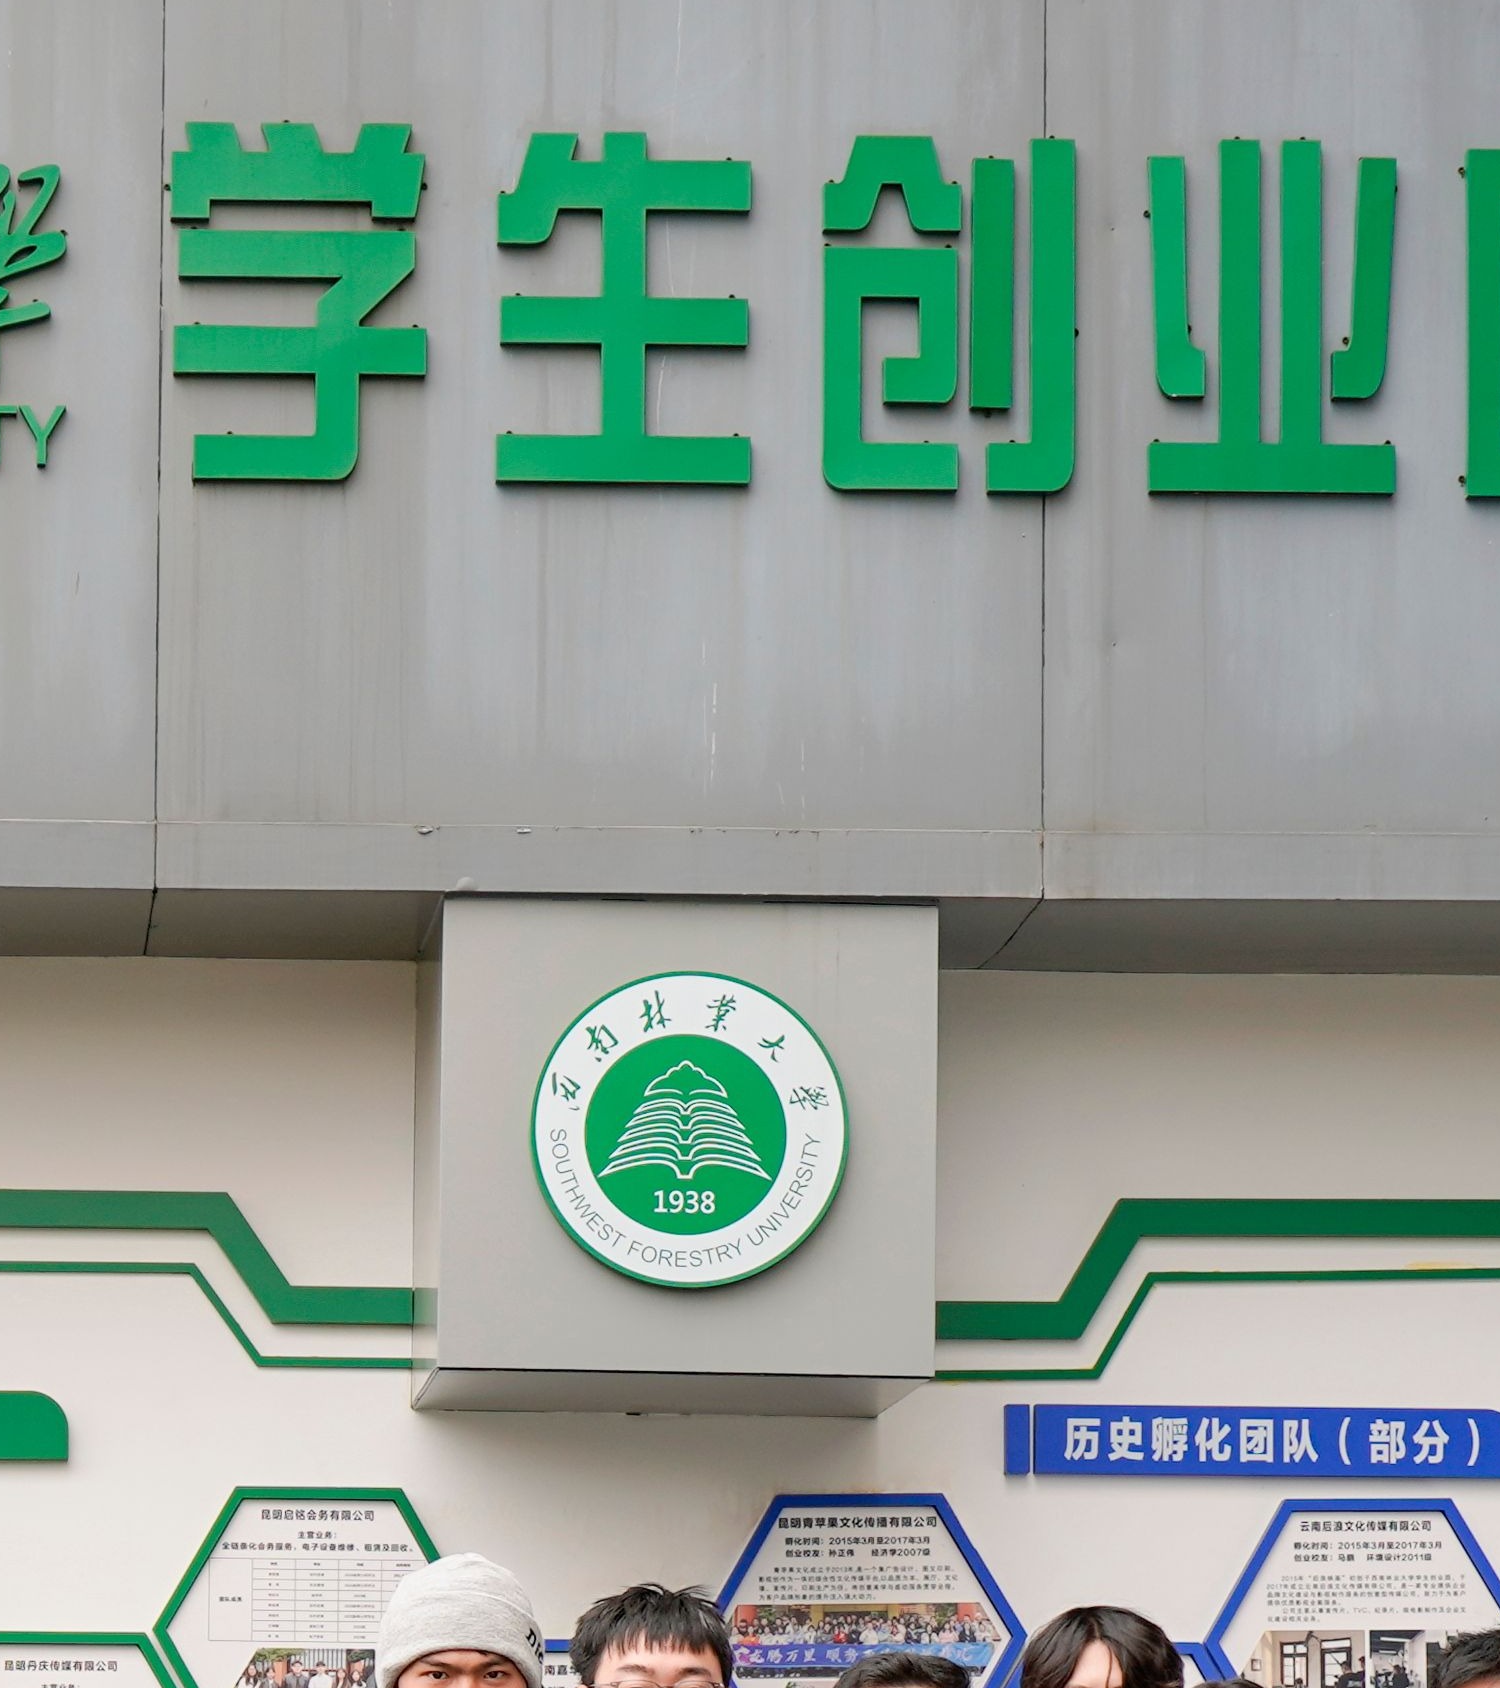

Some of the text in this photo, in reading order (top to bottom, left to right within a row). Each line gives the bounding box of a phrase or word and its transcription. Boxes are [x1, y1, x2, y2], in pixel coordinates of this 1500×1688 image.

[550, 1129, 822, 1269] SOUTHWEST FORESTRY UNIVERSITY
[653, 1190, 716, 1215] 1938
[1063, 1415, 1481, 1467] 历史孵化团队（部分）
